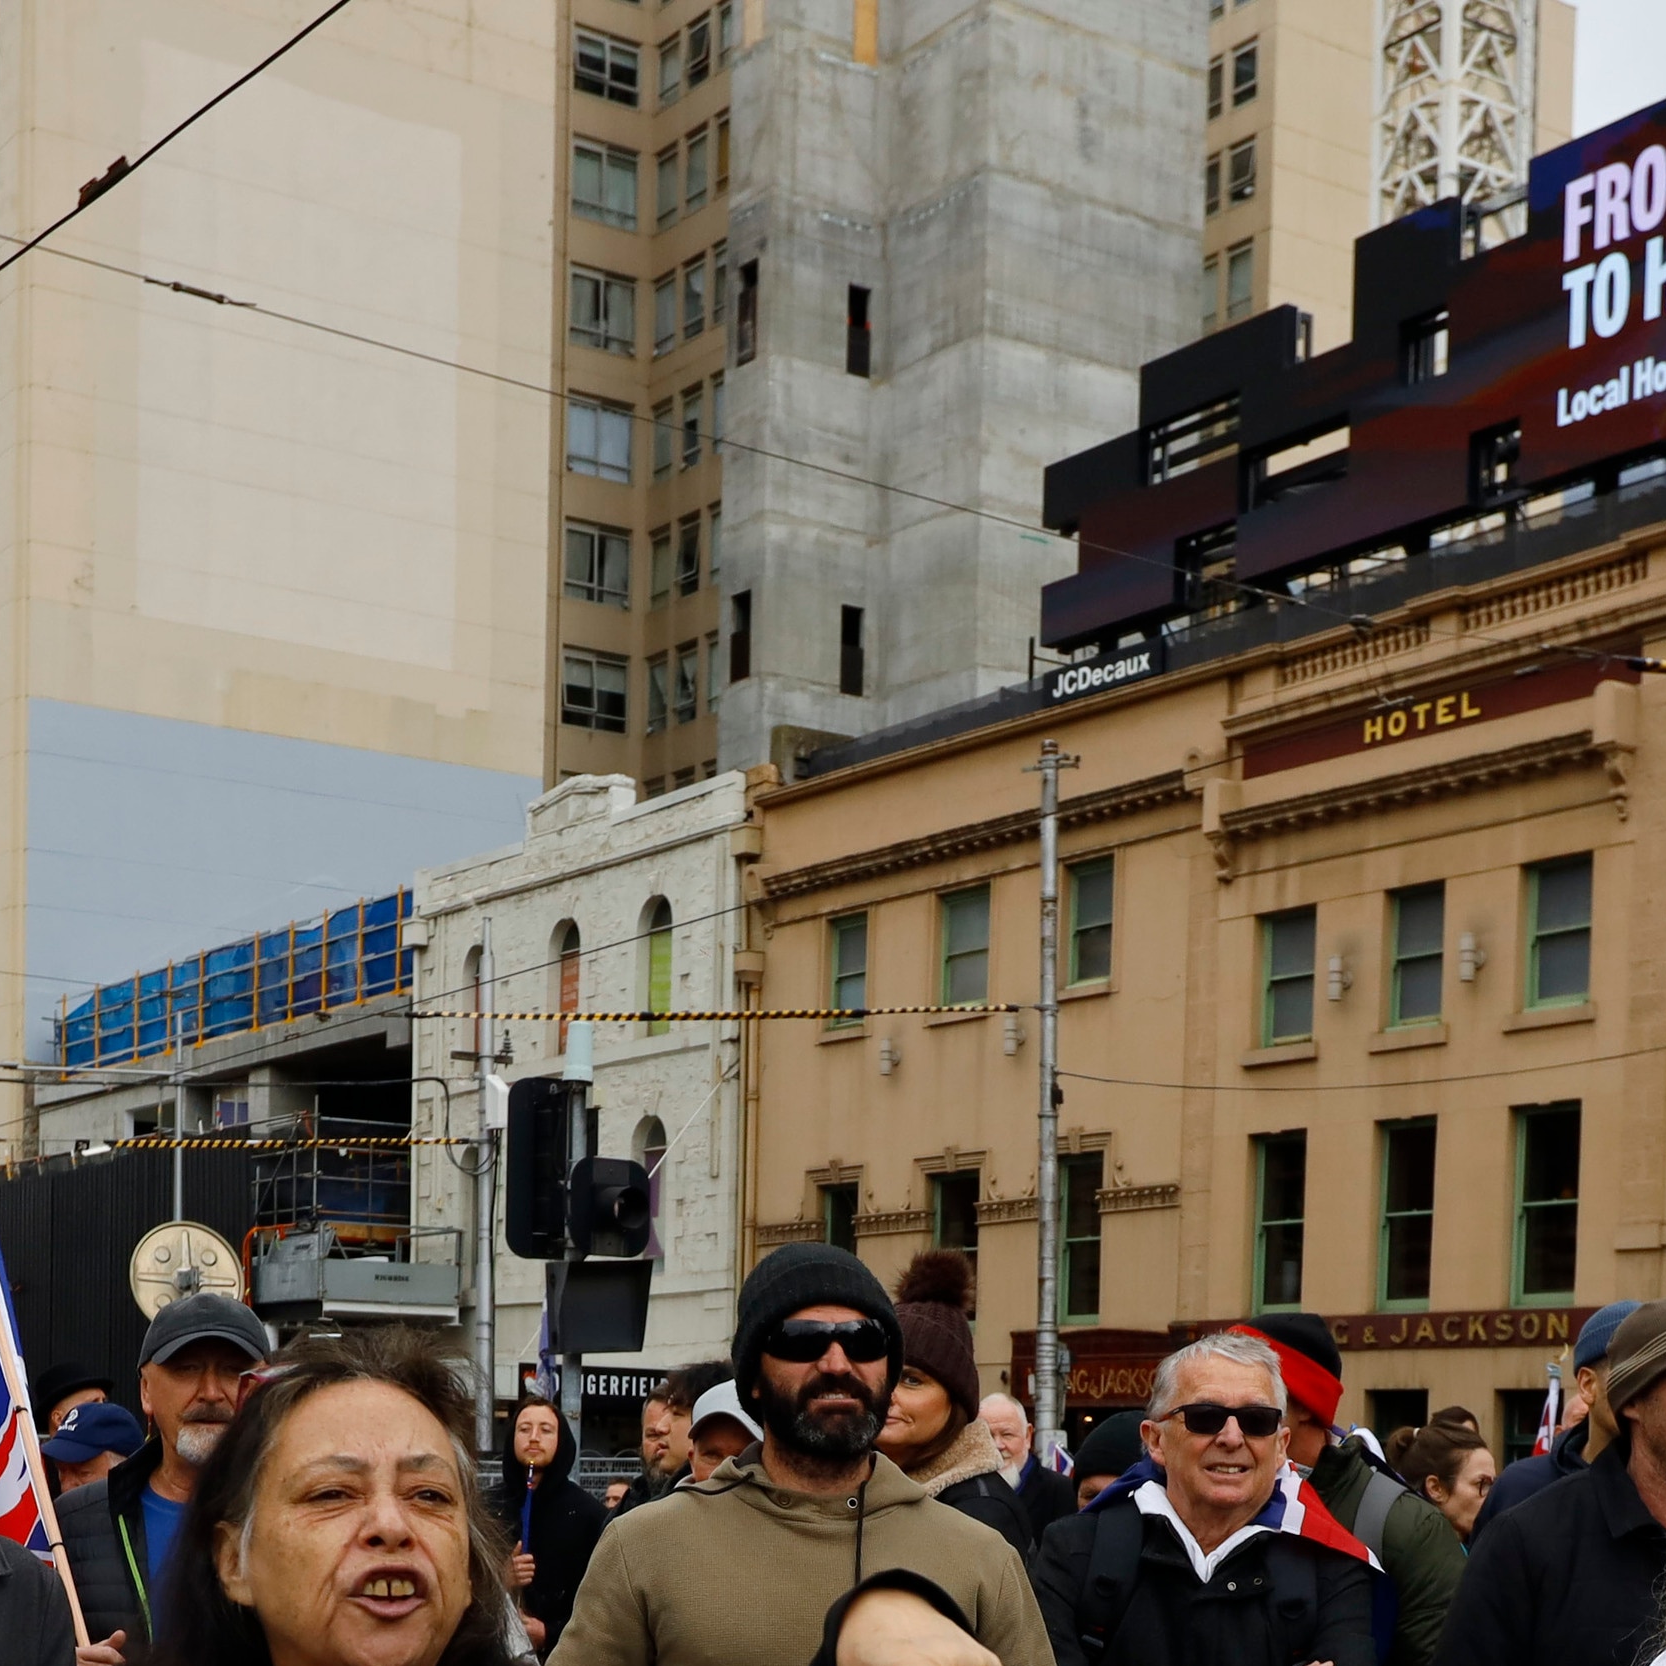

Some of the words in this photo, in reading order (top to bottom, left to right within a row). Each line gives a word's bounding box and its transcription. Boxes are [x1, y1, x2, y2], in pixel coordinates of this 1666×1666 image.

[1562, 247, 1630, 350] TO
[1557, 367, 1629, 427] Local
[1052, 652, 1151, 698] JCDecaux
[1363, 691, 1482, 744] HOTEL
[1389, 1311, 1570, 1344] JACKSON
[1092, 1367, 1157, 1399] JACKSO
